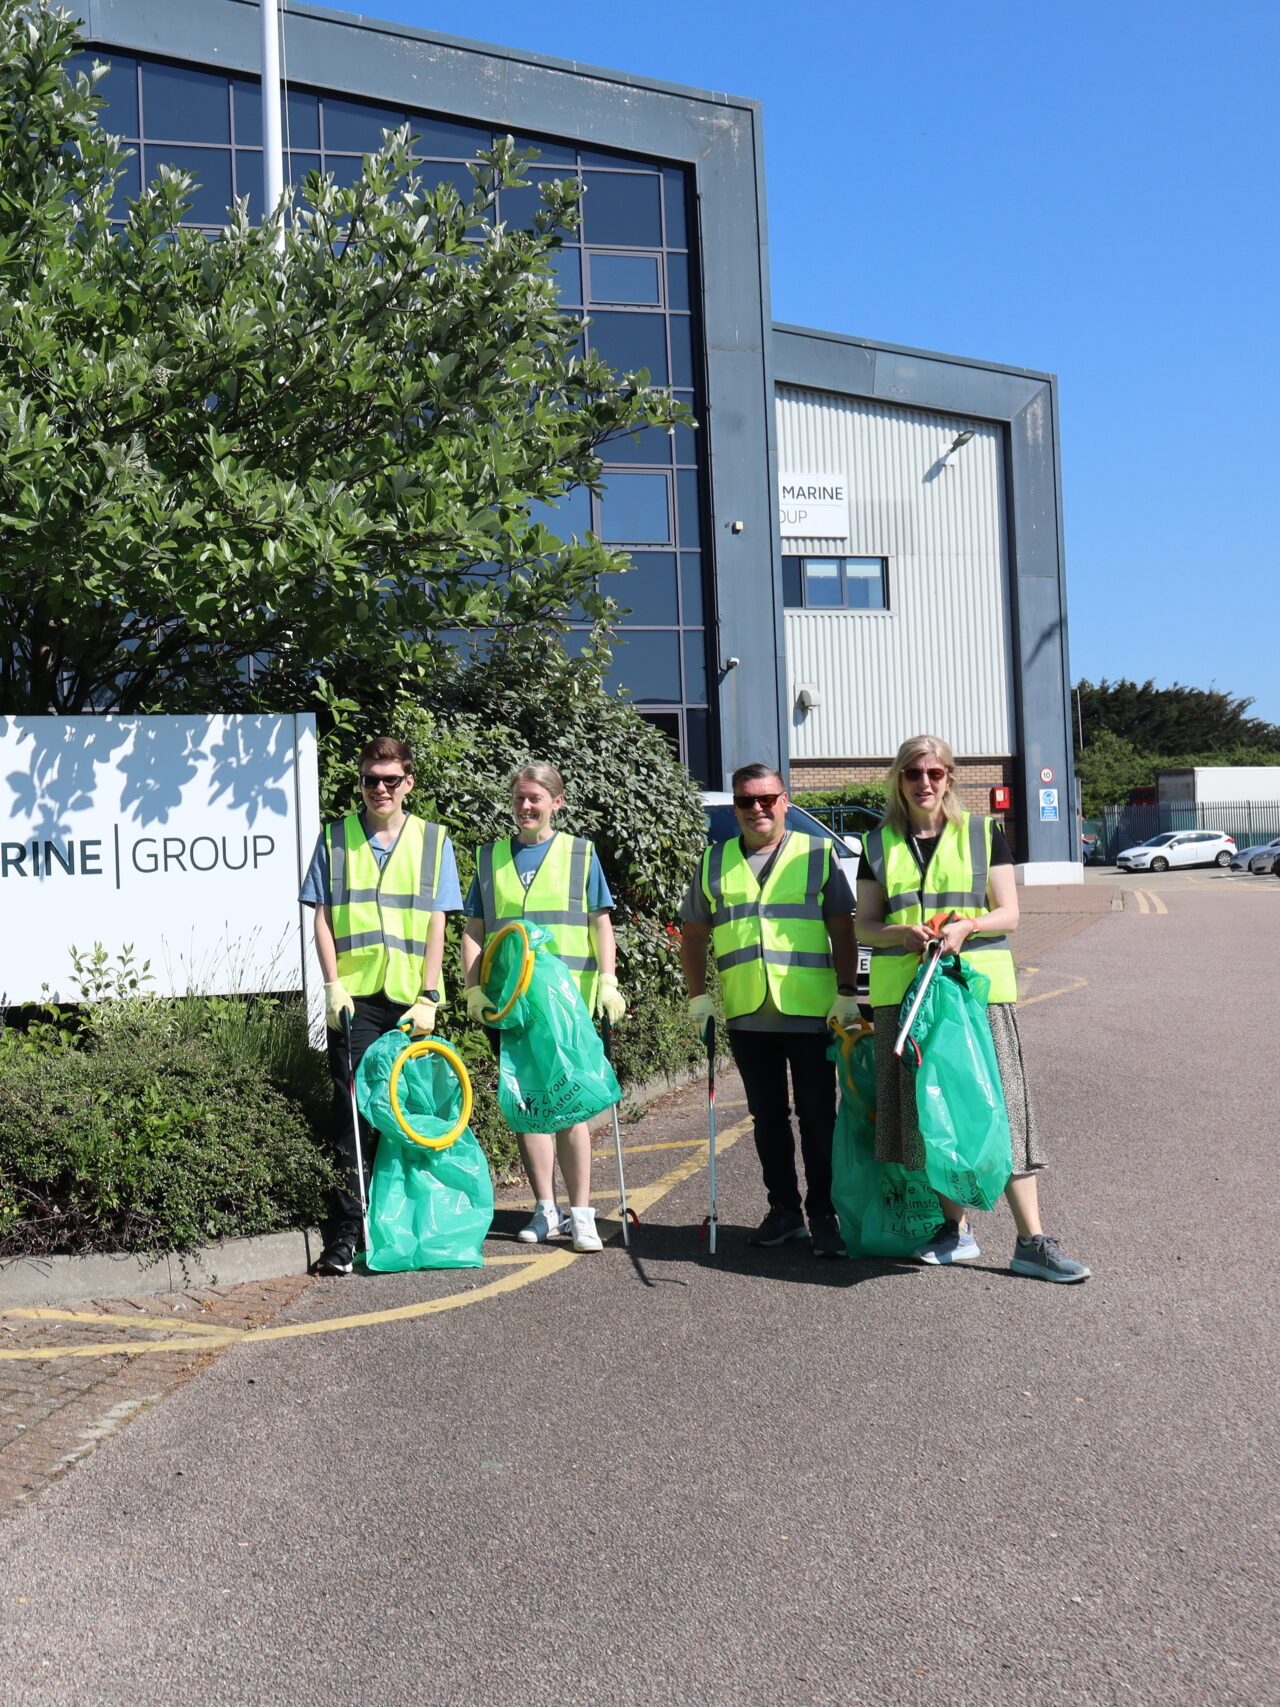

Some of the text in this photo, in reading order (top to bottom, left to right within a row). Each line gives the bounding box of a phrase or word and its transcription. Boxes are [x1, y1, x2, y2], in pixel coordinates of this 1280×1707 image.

[782, 486, 844, 500] MARINE
[779, 509, 808, 524] OUP
[1043, 771, 1051, 779] 10
[131, 834, 275, 873] GROUP
